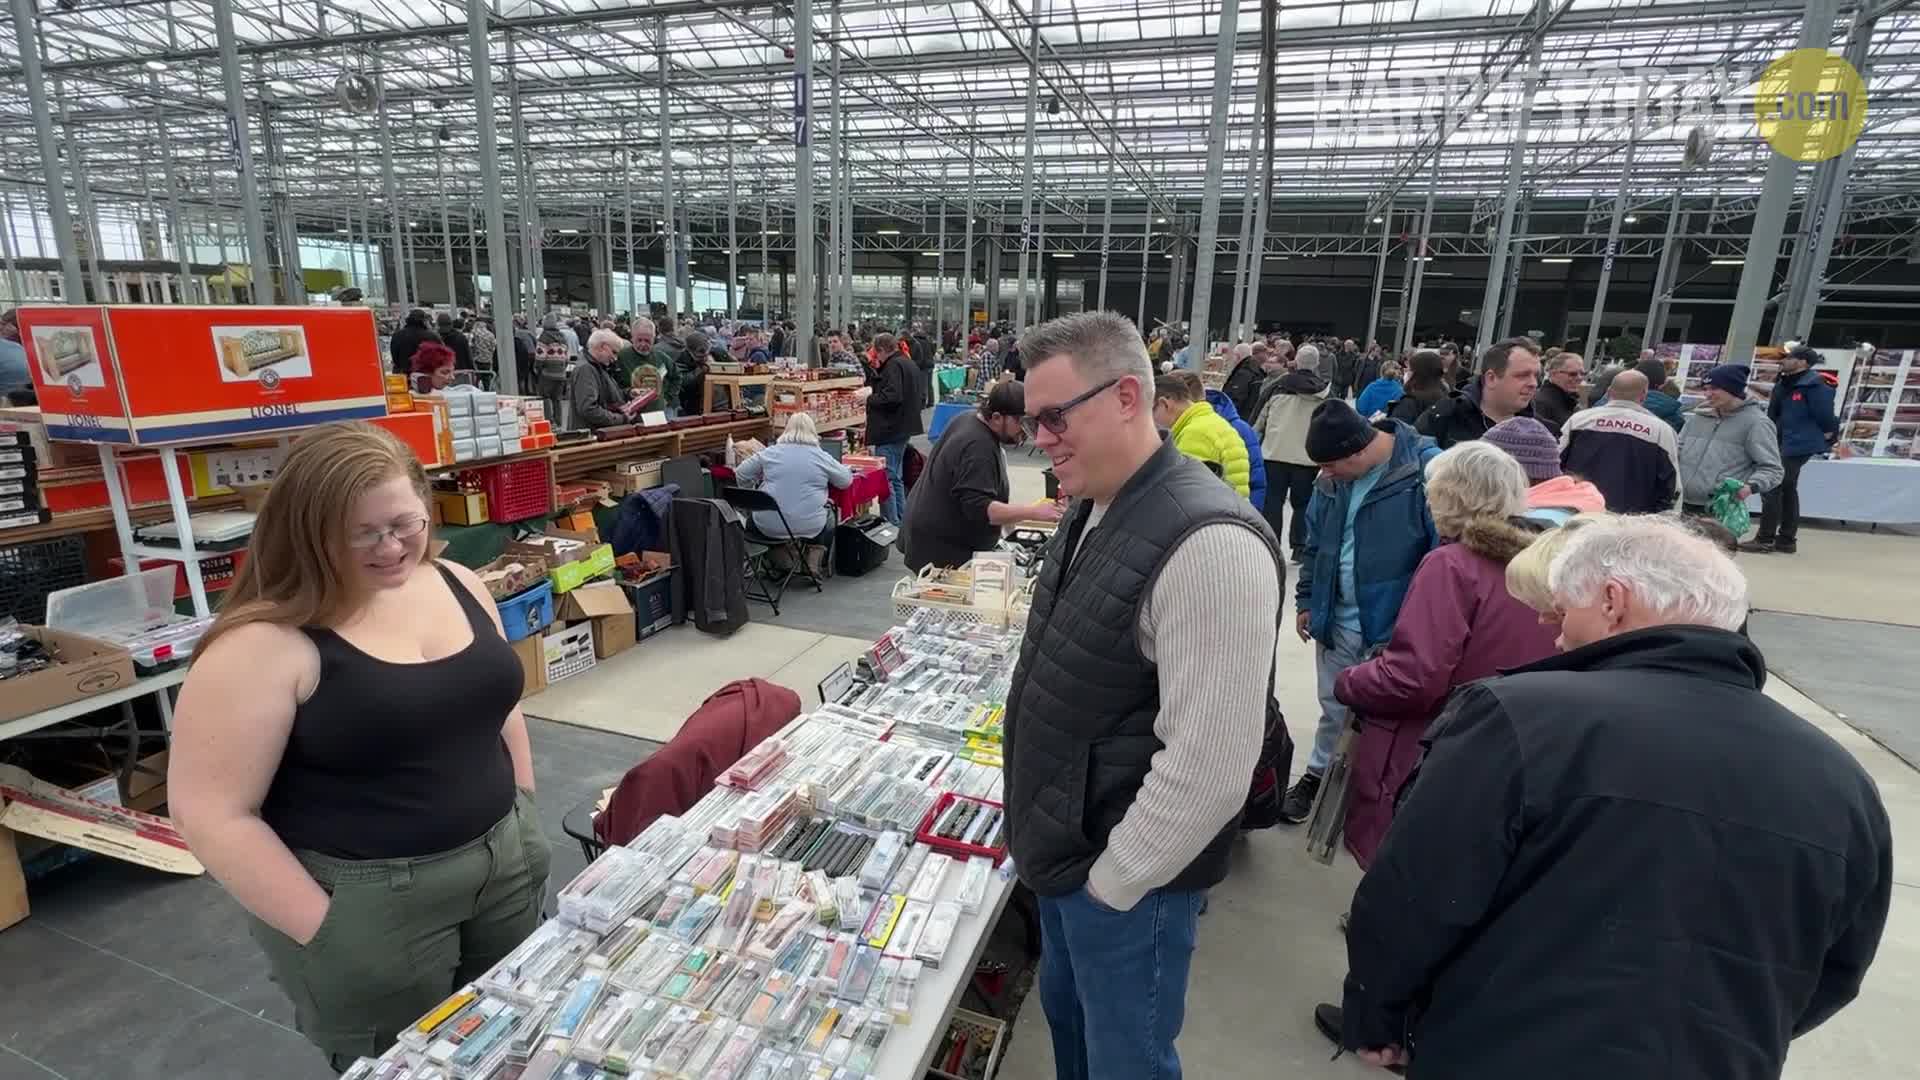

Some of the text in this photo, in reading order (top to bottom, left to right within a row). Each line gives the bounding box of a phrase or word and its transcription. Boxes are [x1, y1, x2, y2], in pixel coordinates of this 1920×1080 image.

[249, 402, 300, 418] LIONEL
[67, 412, 102, 428] LIONEL
[1596, 418, 1651, 436] CANADA
